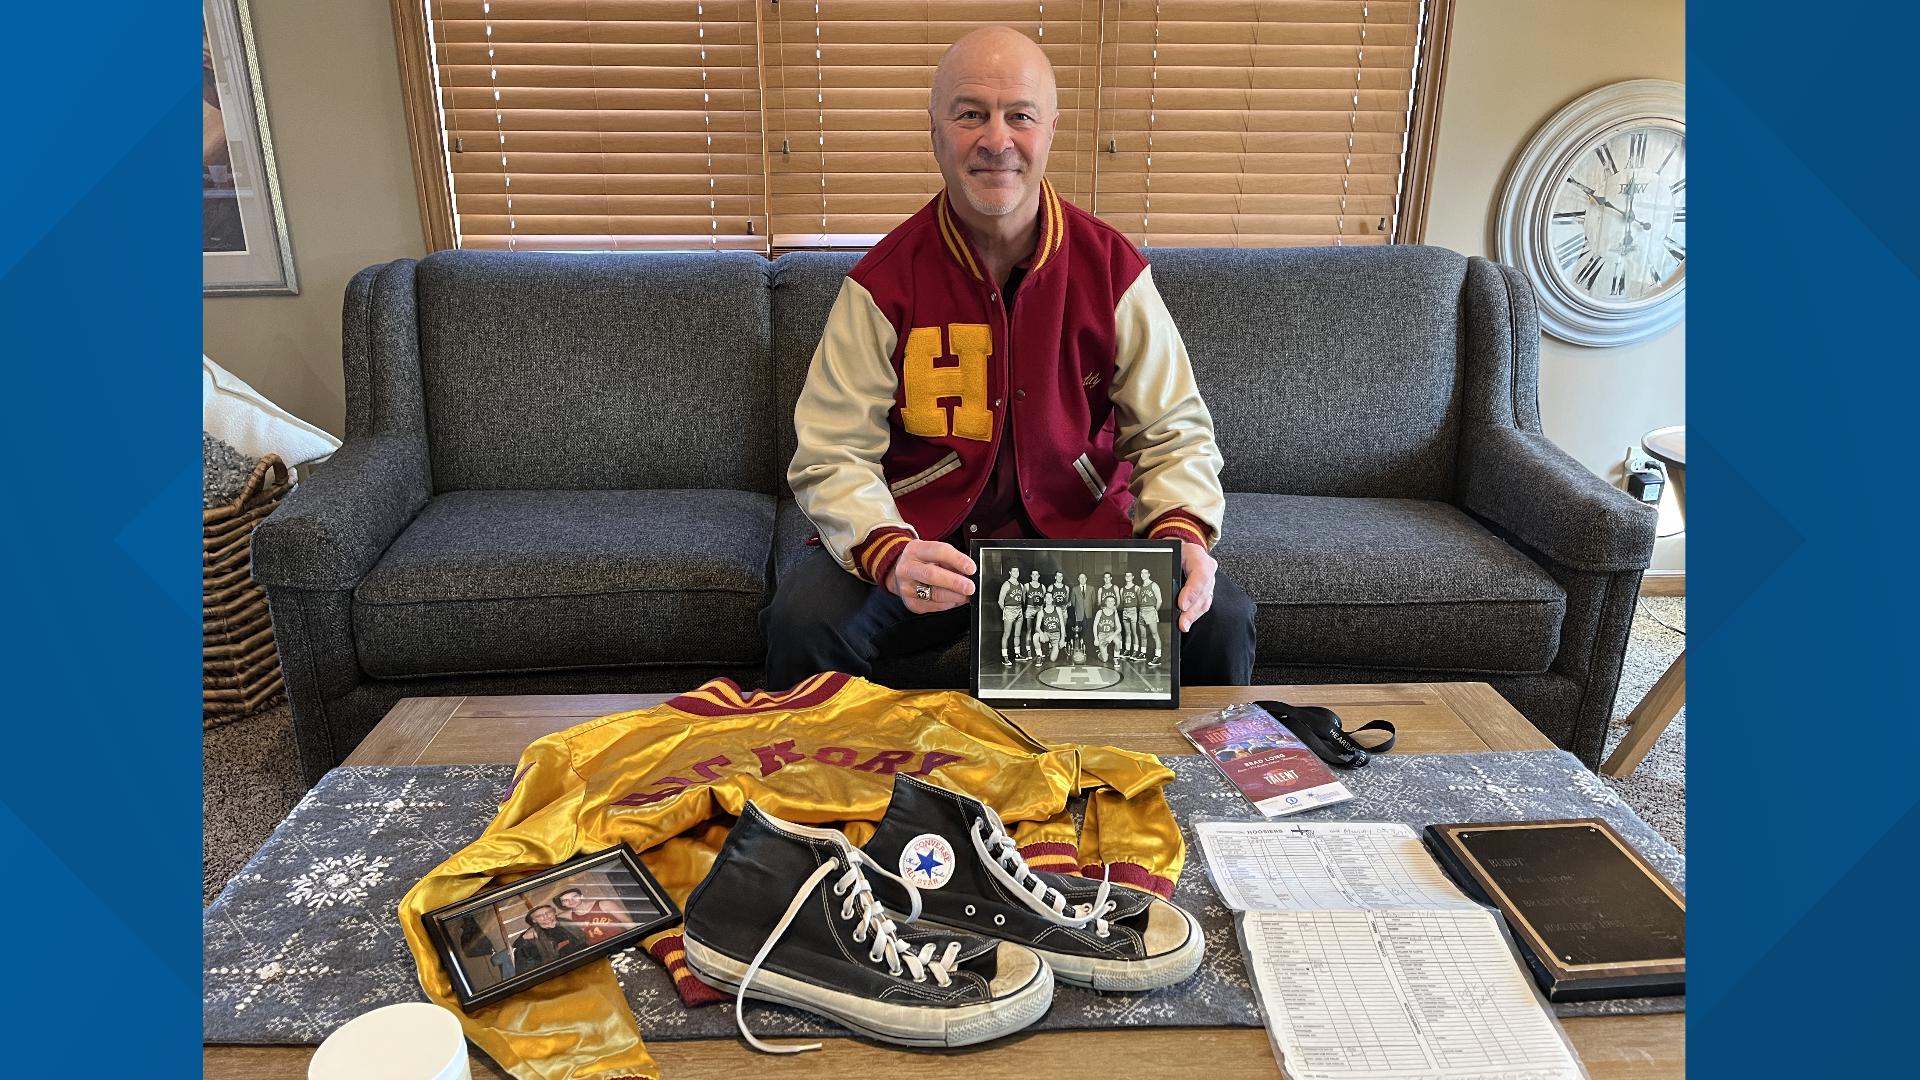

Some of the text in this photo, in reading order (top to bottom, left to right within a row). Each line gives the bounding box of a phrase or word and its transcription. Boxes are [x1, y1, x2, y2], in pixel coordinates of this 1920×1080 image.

[900, 322, 994, 442] H
[1244, 759, 1264, 768] BRAD
[1265, 753, 1287, 762] LONG
[1263, 769, 1299, 785] TALENT
[914, 839, 952, 863] CONVERSE
[917, 878, 939, 886] STAR
